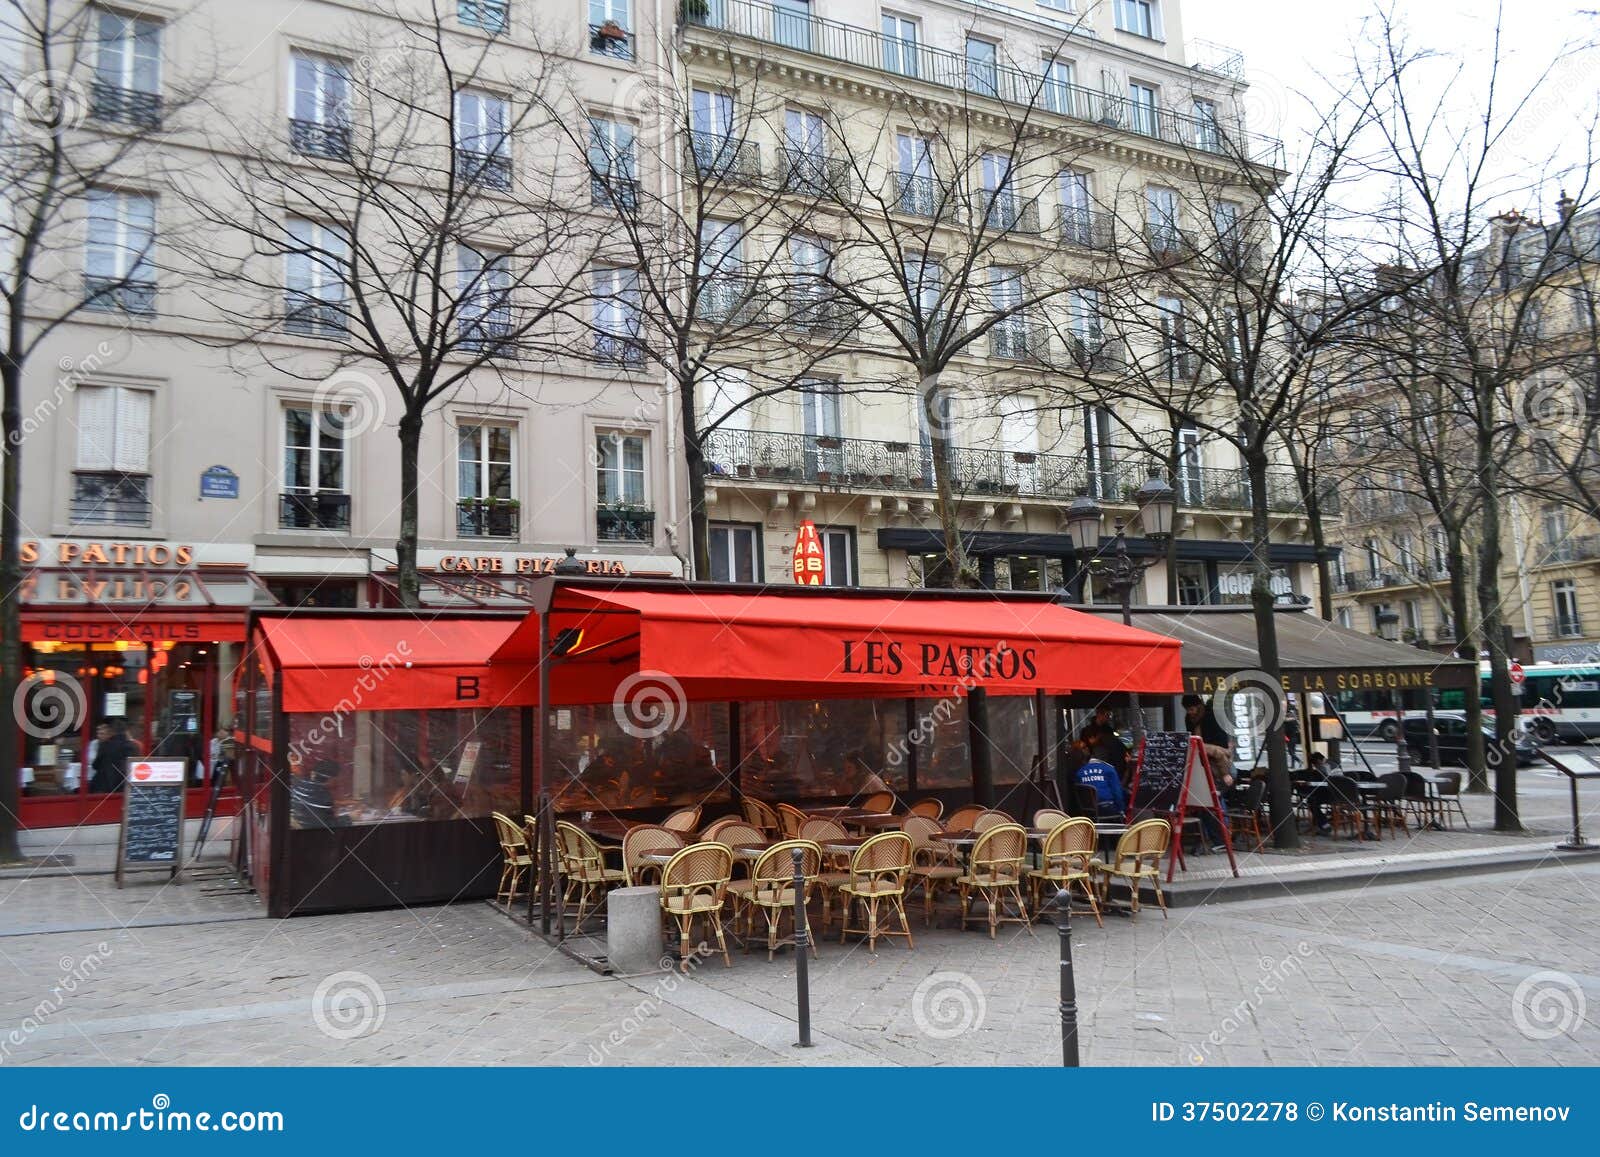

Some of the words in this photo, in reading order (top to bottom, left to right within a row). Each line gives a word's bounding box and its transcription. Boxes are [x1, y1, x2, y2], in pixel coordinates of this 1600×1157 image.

[58, 543, 193, 565] PATIOS
[440, 556, 504, 573] CAFE
[516, 558, 628, 575] PIZRIA
[44, 623, 200, 639] COCKTAILS
[841, 640, 903, 675] LES
[918, 643, 1037, 681] PATIOS
[456, 675, 480, 700] B
[1189, 675, 1248, 691] TABA
[1303, 675, 1325, 690] LA
[1337, 673, 1434, 689] SORBONNE
